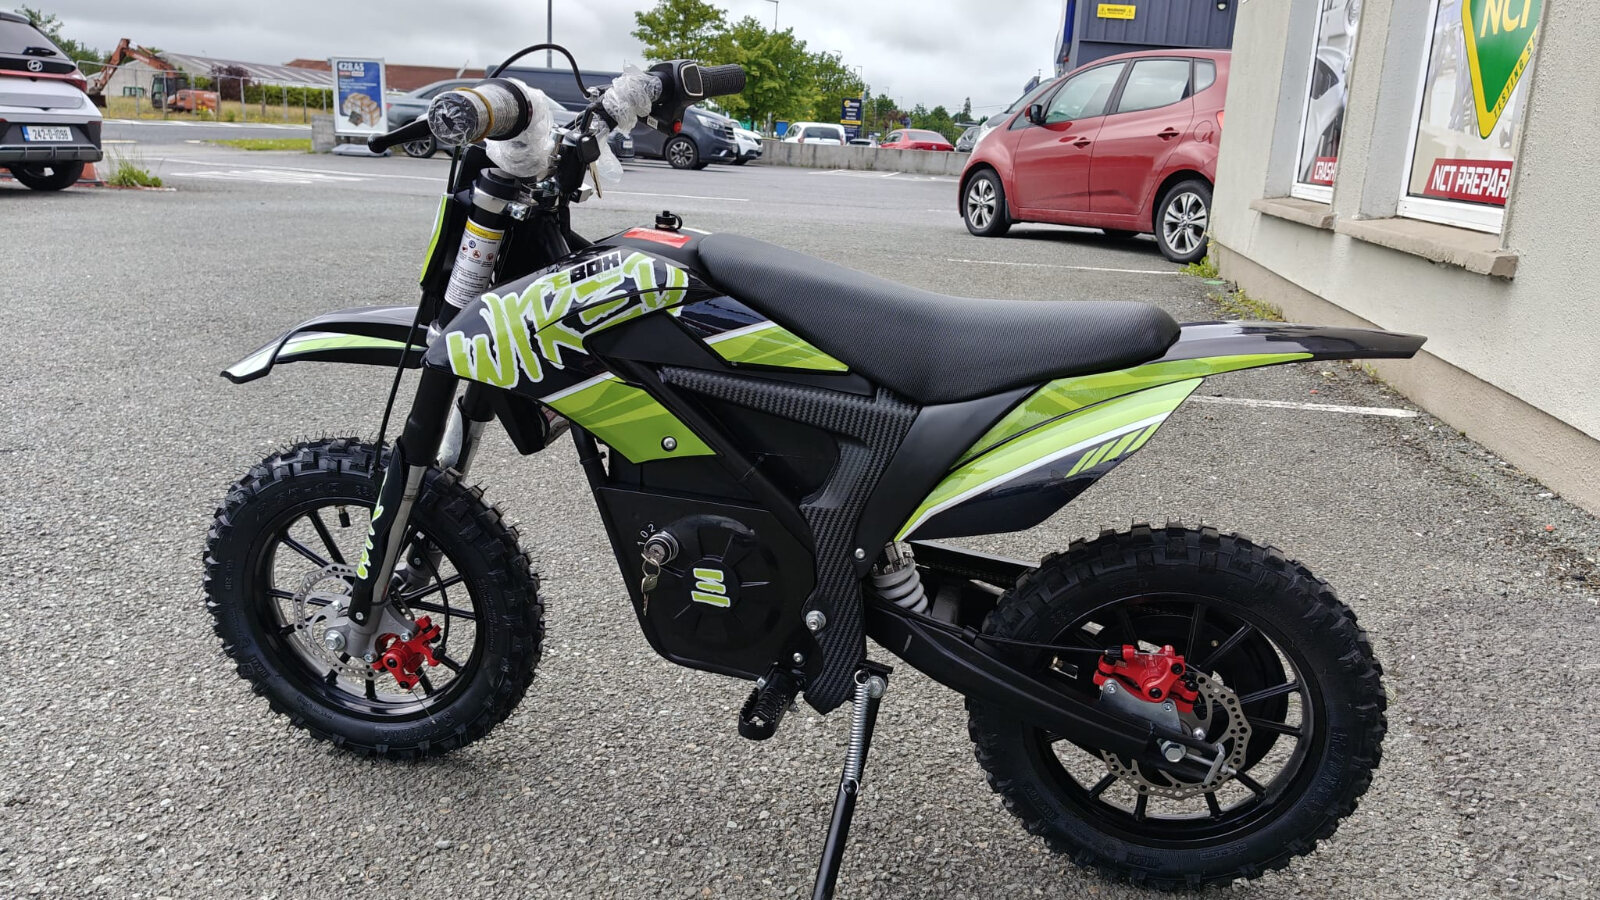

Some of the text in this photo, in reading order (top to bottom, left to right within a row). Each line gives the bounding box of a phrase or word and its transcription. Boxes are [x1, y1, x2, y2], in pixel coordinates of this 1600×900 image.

[1493, 59, 1524, 118] TESTING
[1431, 164, 1510, 198] NCT PREPAR
